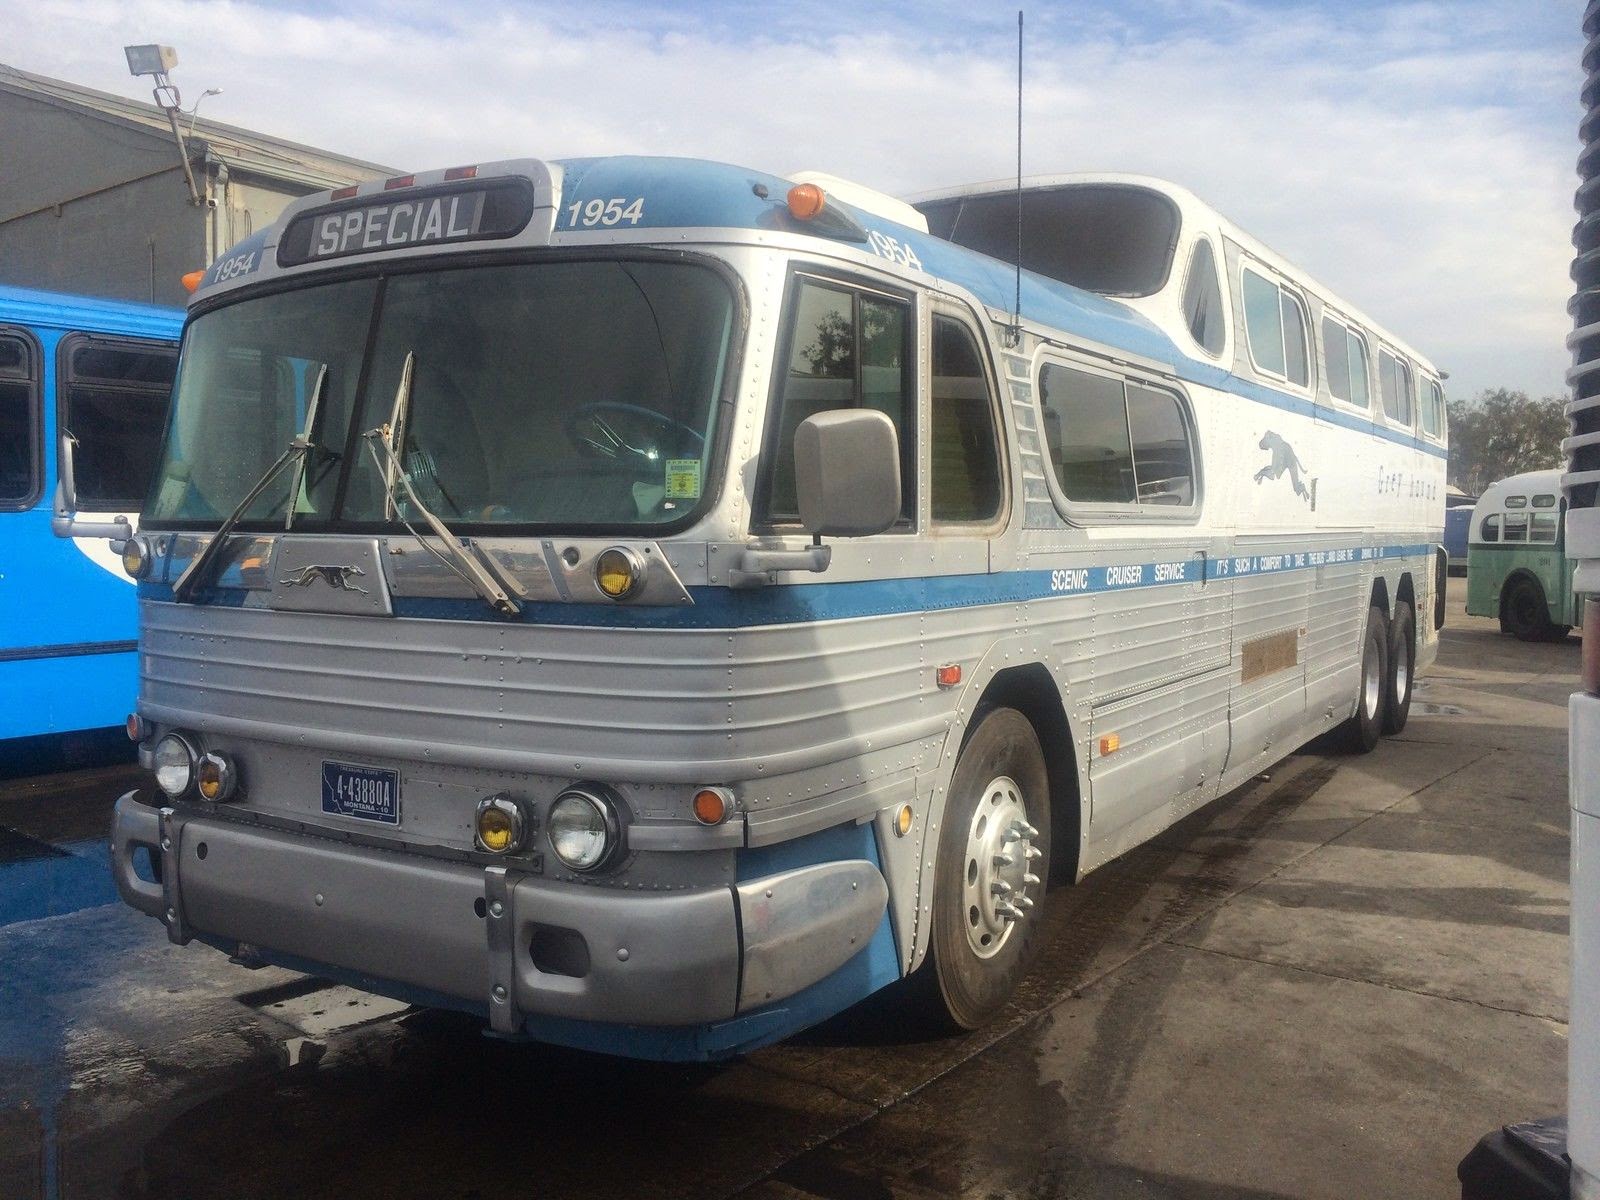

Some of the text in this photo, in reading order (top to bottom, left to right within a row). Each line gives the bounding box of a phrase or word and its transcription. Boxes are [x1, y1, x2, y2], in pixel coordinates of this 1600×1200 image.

[317, 197, 468, 255] SPECIAL
[568, 198, 644, 227] 1954
[865, 229, 922, 272] 1954
[214, 251, 255, 283] 1954
[1051, 562, 1185, 591] SCENIC CRUISER SERVICE
[1216, 559, 1229, 575] IT'S
[1234, 557, 1251, 573] SUCH
[1252, 557, 1258, 571] A
[1260, 555, 1282, 571] COMFORT
[1284, 554, 1291, 568] TO
[343, 800, 375, 812] MONTANA
